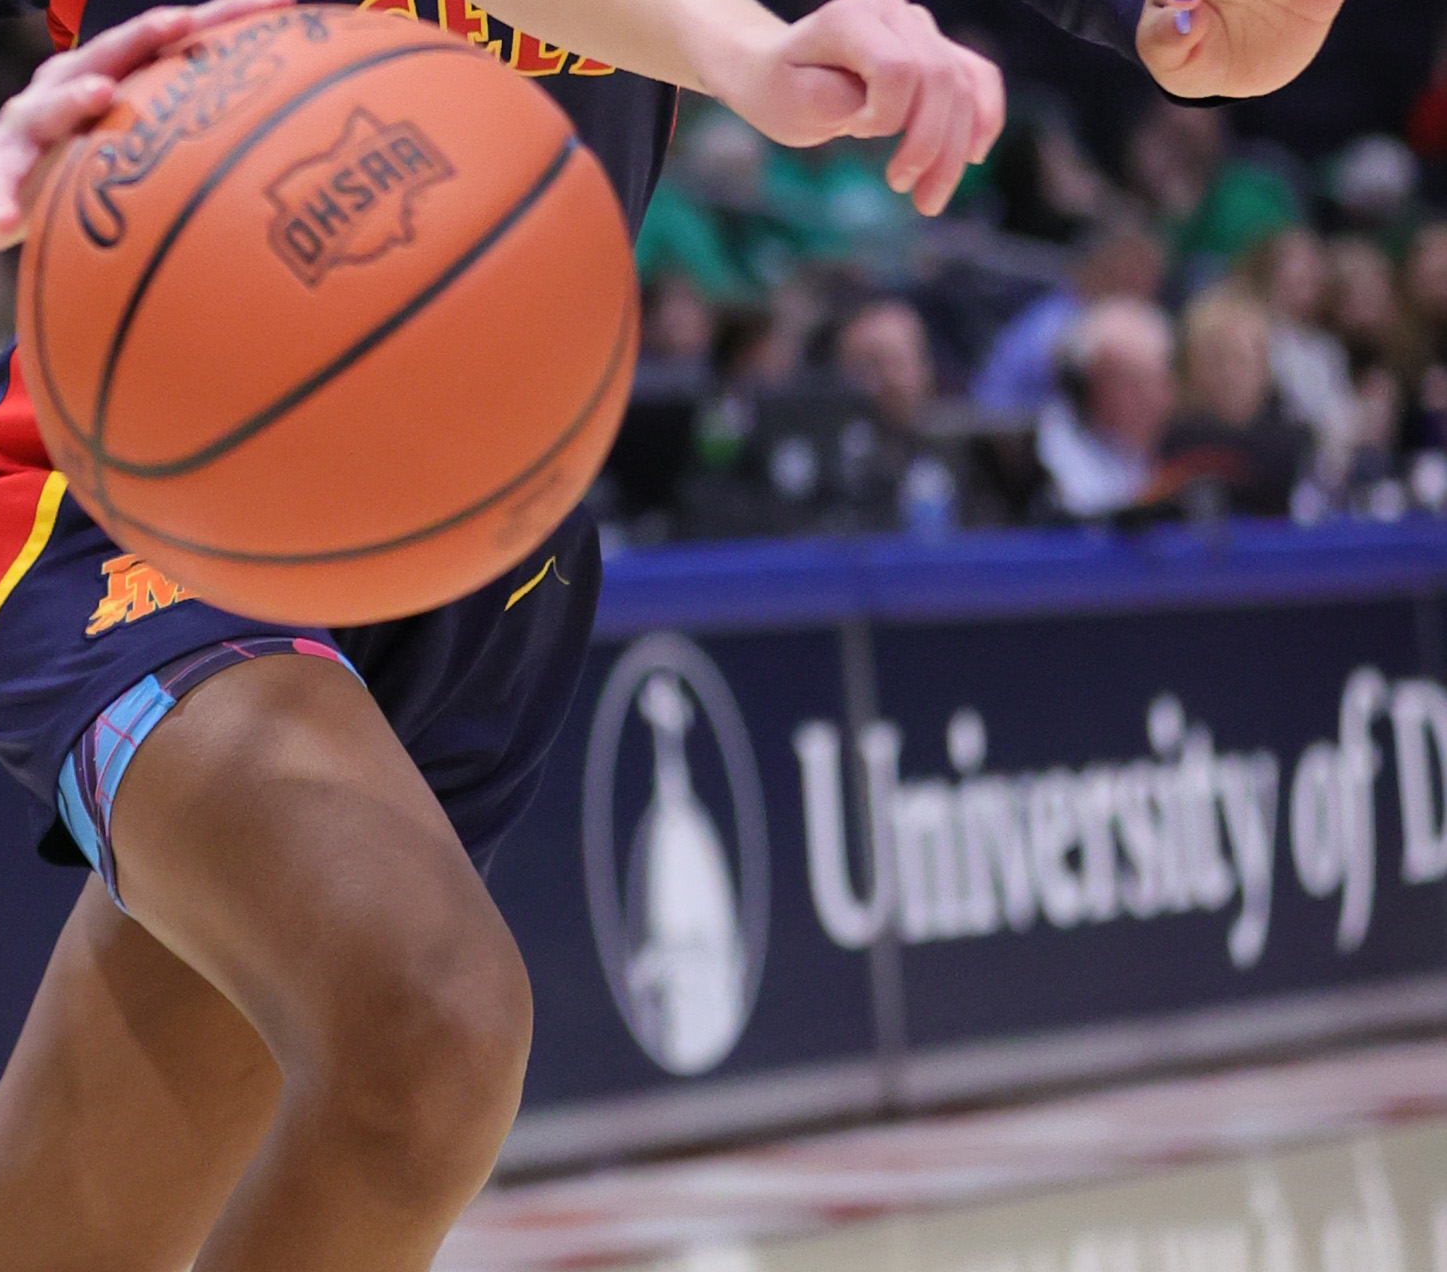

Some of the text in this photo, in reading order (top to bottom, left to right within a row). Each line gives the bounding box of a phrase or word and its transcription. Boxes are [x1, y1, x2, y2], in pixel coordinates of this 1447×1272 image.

[284, 135, 435, 265] OHSAA
[793, 695, 1281, 970] University
[1289, 664, 1383, 954] of
